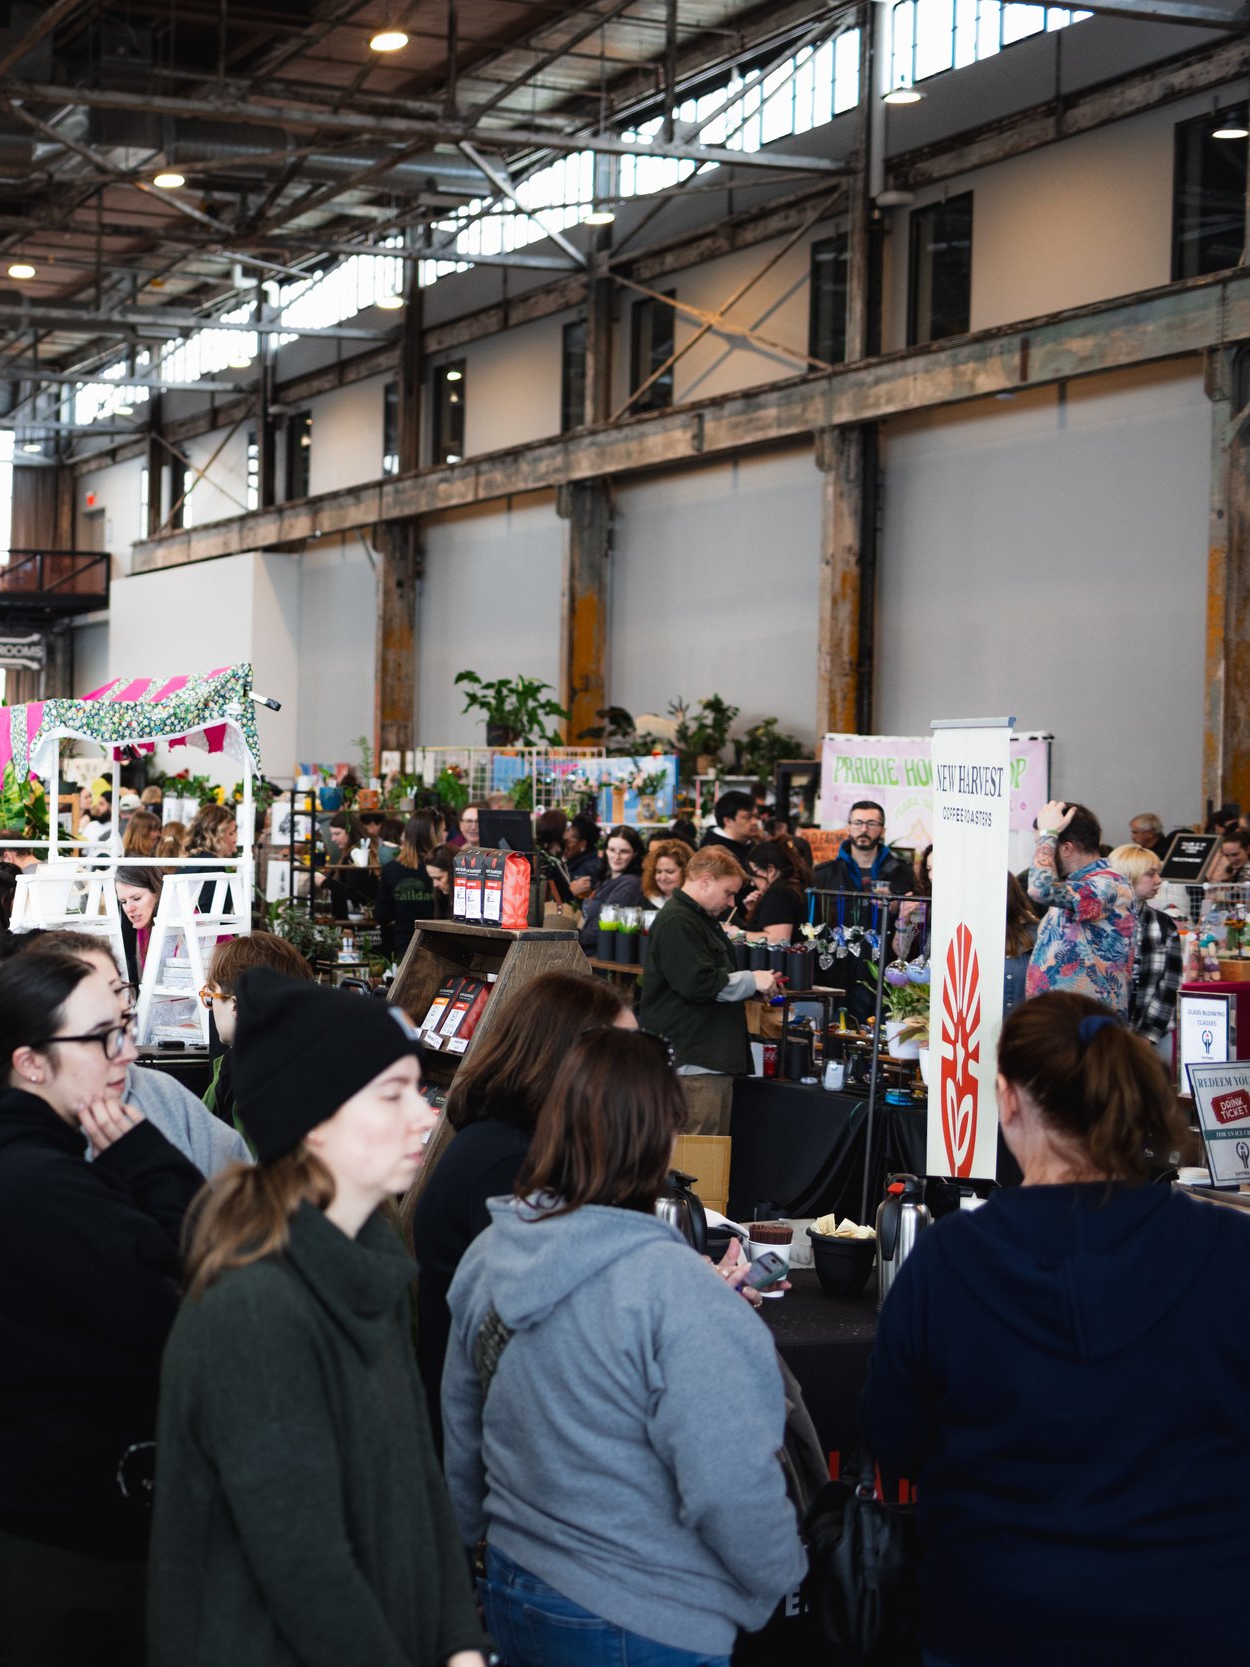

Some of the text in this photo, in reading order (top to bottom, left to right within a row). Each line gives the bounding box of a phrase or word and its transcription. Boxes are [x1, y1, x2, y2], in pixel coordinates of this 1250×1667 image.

[833, 756, 899, 786] PRAIRIE
[904, 758, 932, 787] HO
[936, 765, 1003, 797] NEW HARVEST
[943, 806, 992, 827] COFFEE ROASTERS
[1197, 1077, 1232, 1088] REDEEM
[1220, 1097, 1244, 1110] DRINK
[1221, 1105, 1248, 1119] TICKET
